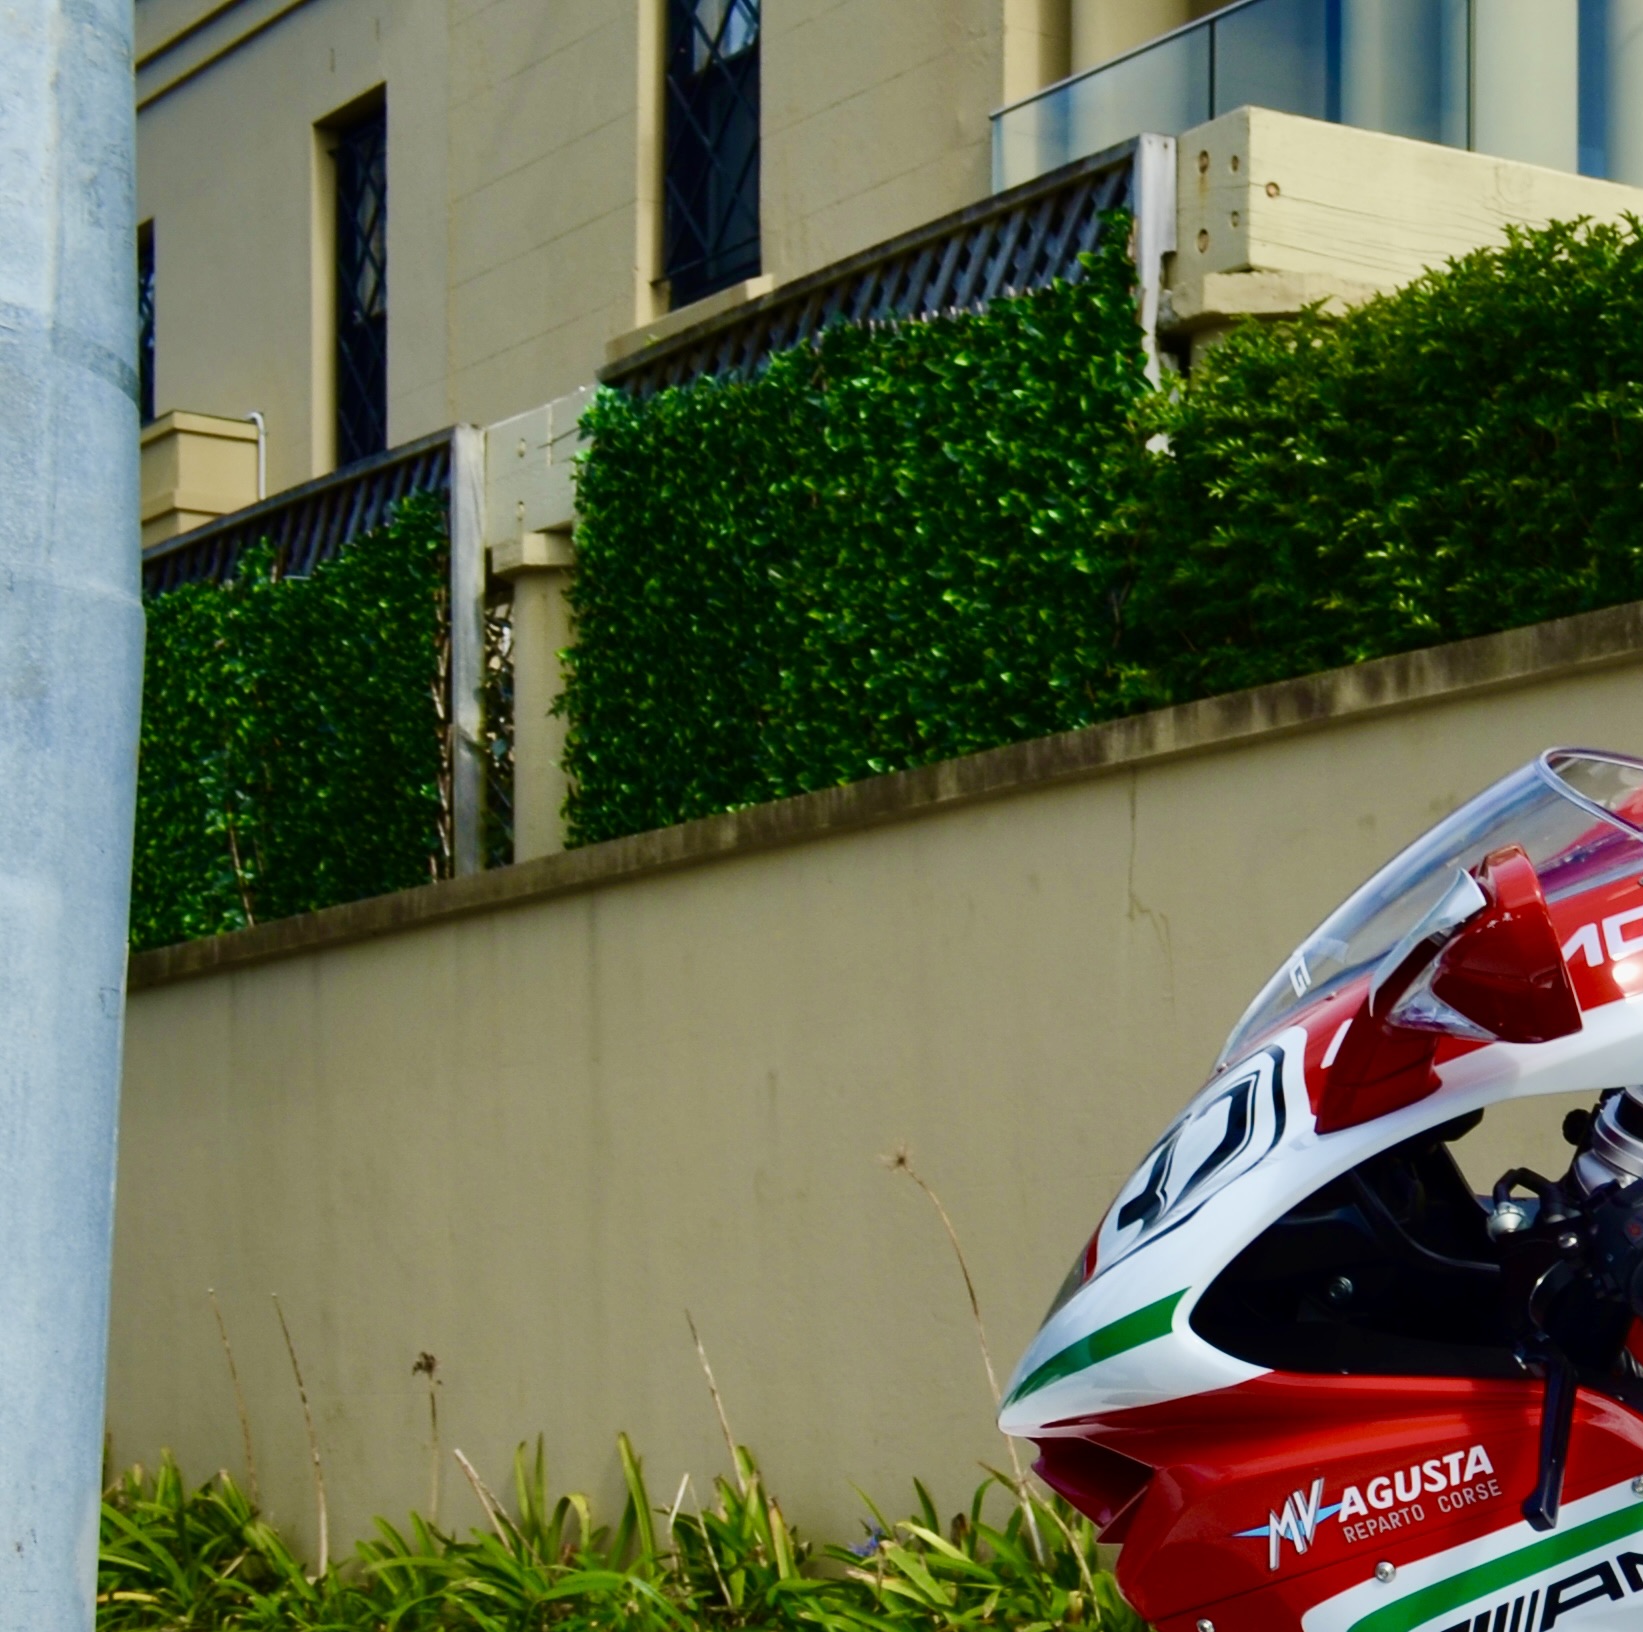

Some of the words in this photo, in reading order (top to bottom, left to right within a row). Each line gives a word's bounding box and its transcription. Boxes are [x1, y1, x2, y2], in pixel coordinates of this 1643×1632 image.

[1268, 1477, 1325, 1570] MV
[1338, 1444, 1495, 1524] AGUSTA
[1343, 1504, 1426, 1544] REPARTO
[1437, 1477, 1503, 1514] CORSE
